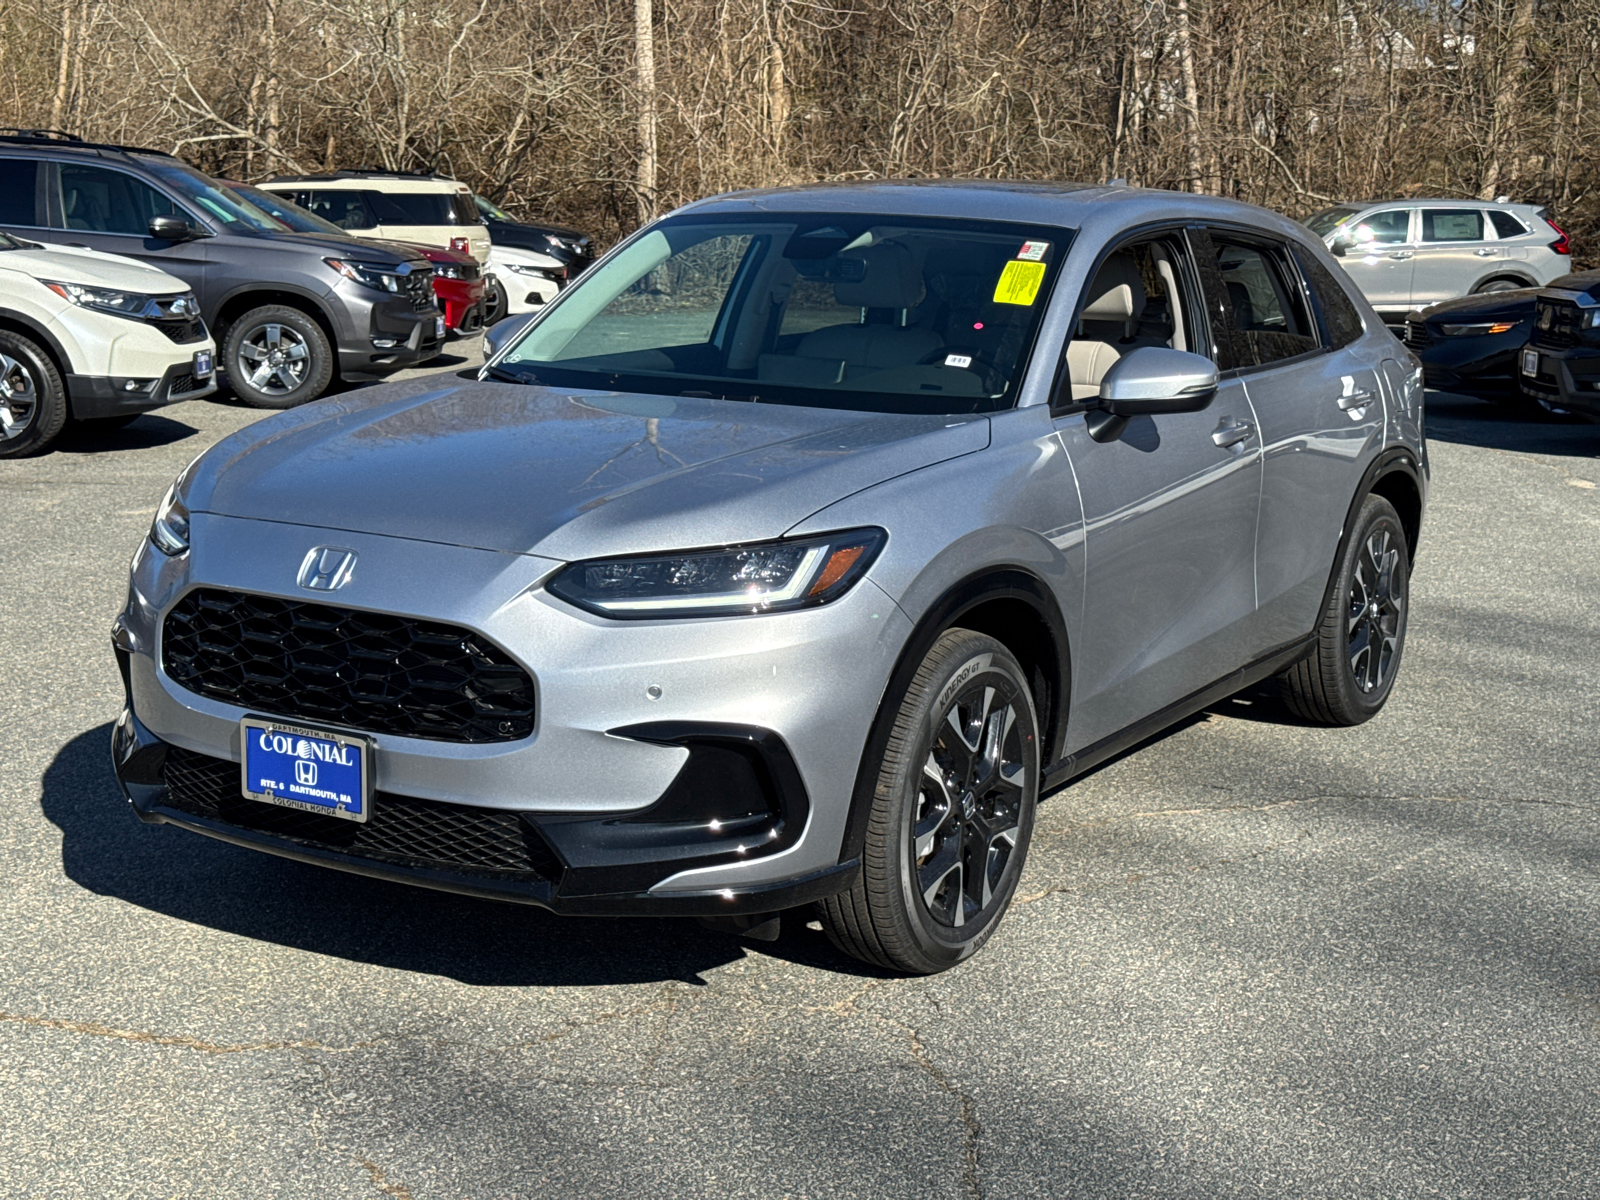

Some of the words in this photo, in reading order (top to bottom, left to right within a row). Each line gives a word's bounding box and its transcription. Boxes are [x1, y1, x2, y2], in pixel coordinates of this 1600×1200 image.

[972, 662, 980, 673] GT
[260, 733, 353, 766] COLONIAL
[260, 779, 278, 789] RTE.
[279, 782, 285, 790] 6
[290, 784, 339, 801] DARTMOUTH,
[340, 794, 352, 803] MA
[273, 798, 308, 810] COLONIAL
[310, 805, 336, 815] HONDA
